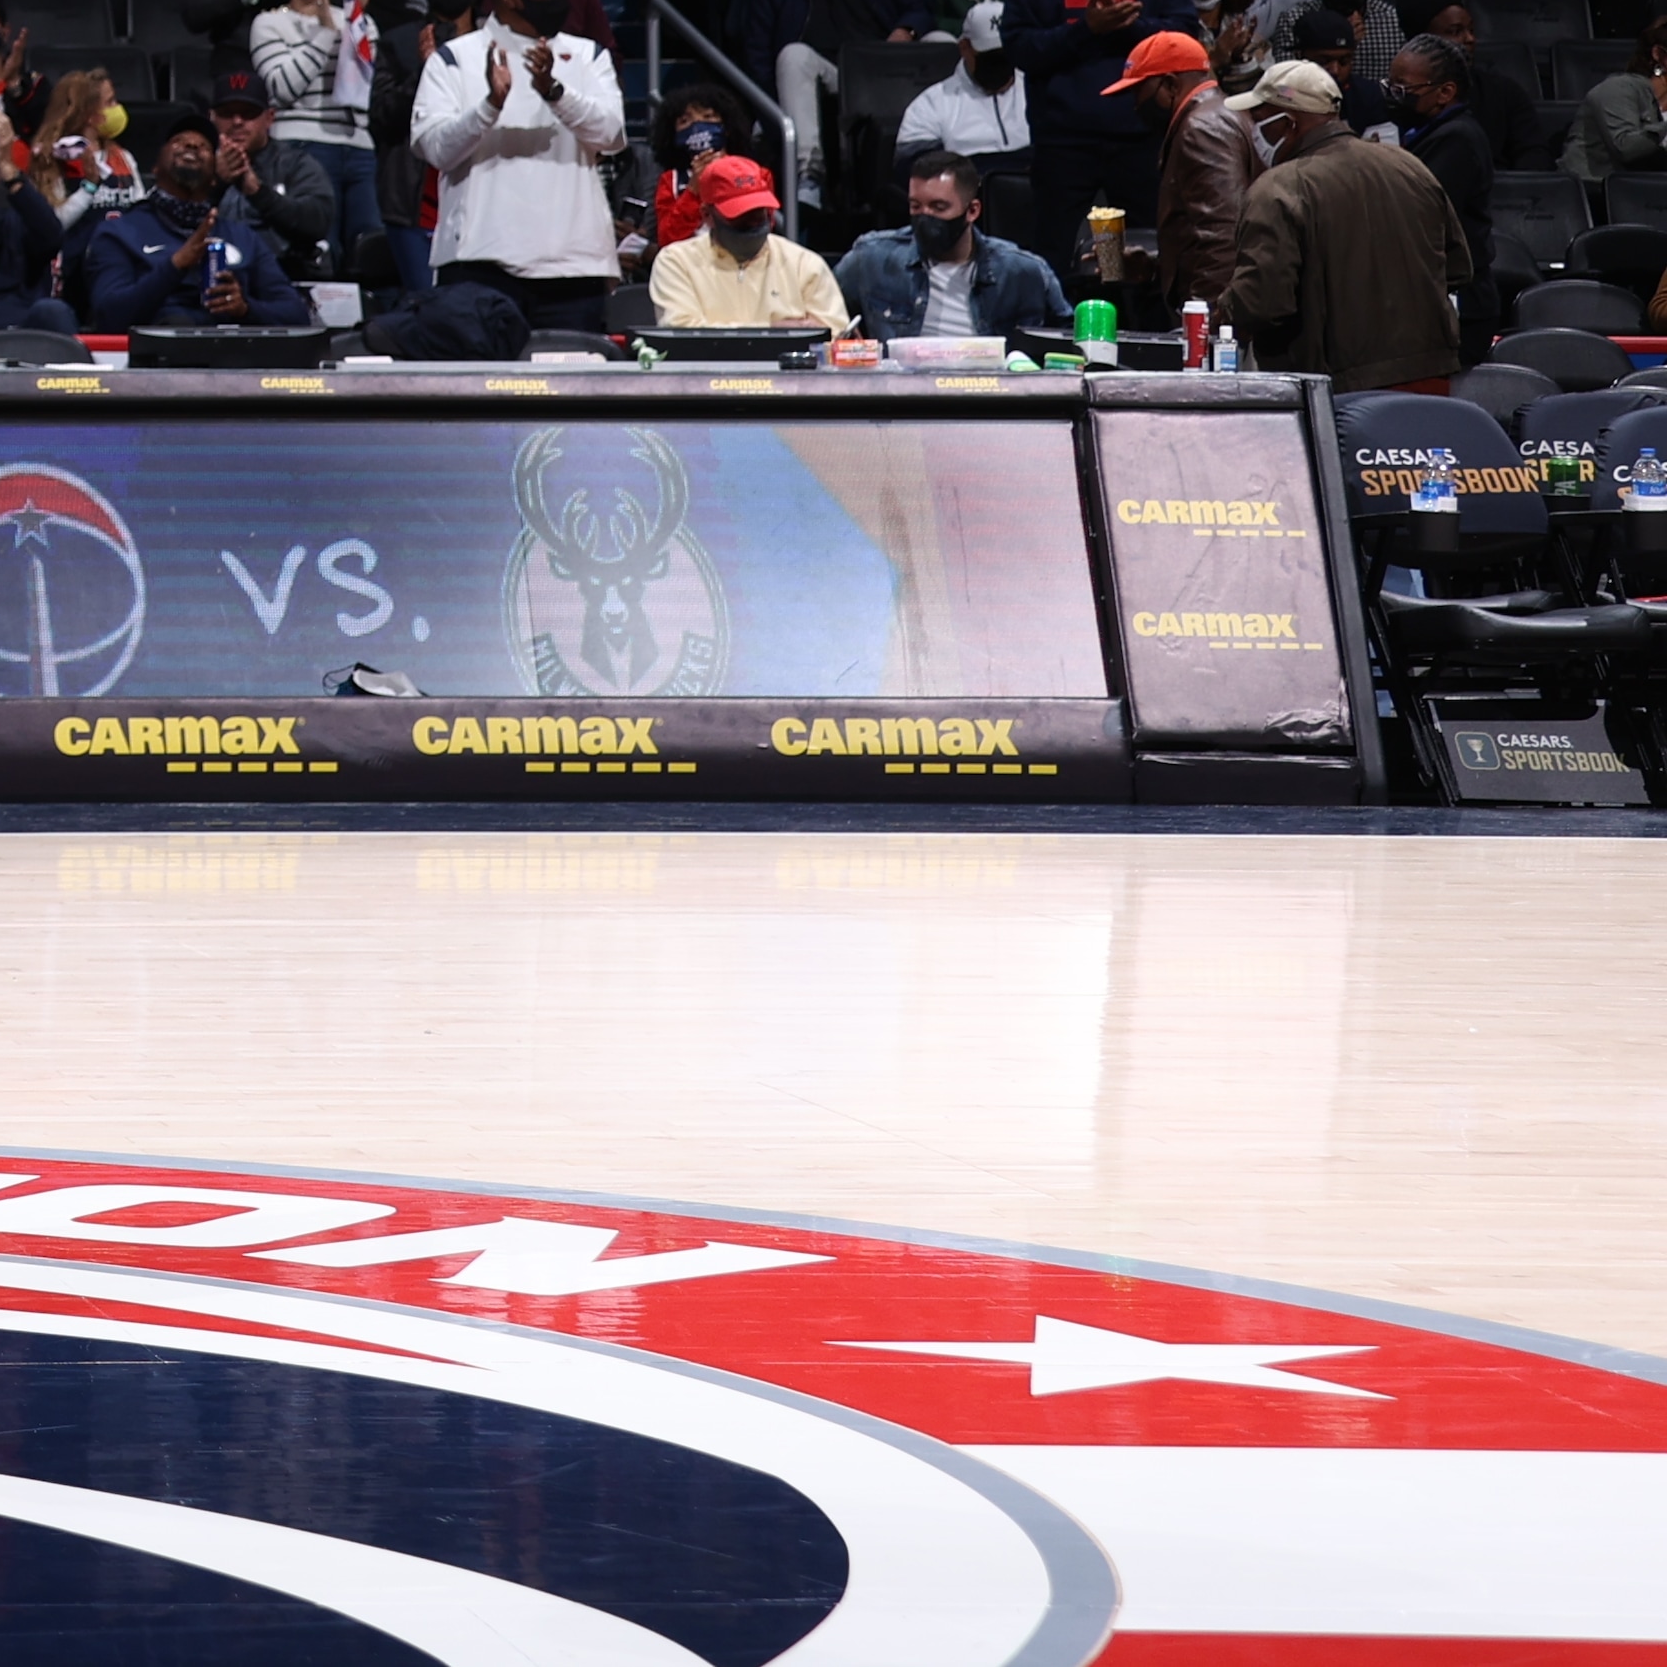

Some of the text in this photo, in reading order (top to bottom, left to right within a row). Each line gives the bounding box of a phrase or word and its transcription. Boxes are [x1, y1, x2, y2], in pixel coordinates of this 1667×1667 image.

[1519, 439, 1595, 456] CAESA
[1360, 466, 1540, 497] SPOSBOOK
[219, 539, 430, 642] VS.
[1497, 733, 1572, 749] CAESARS
[1501, 750, 1630, 773] SPORTSBOOK
